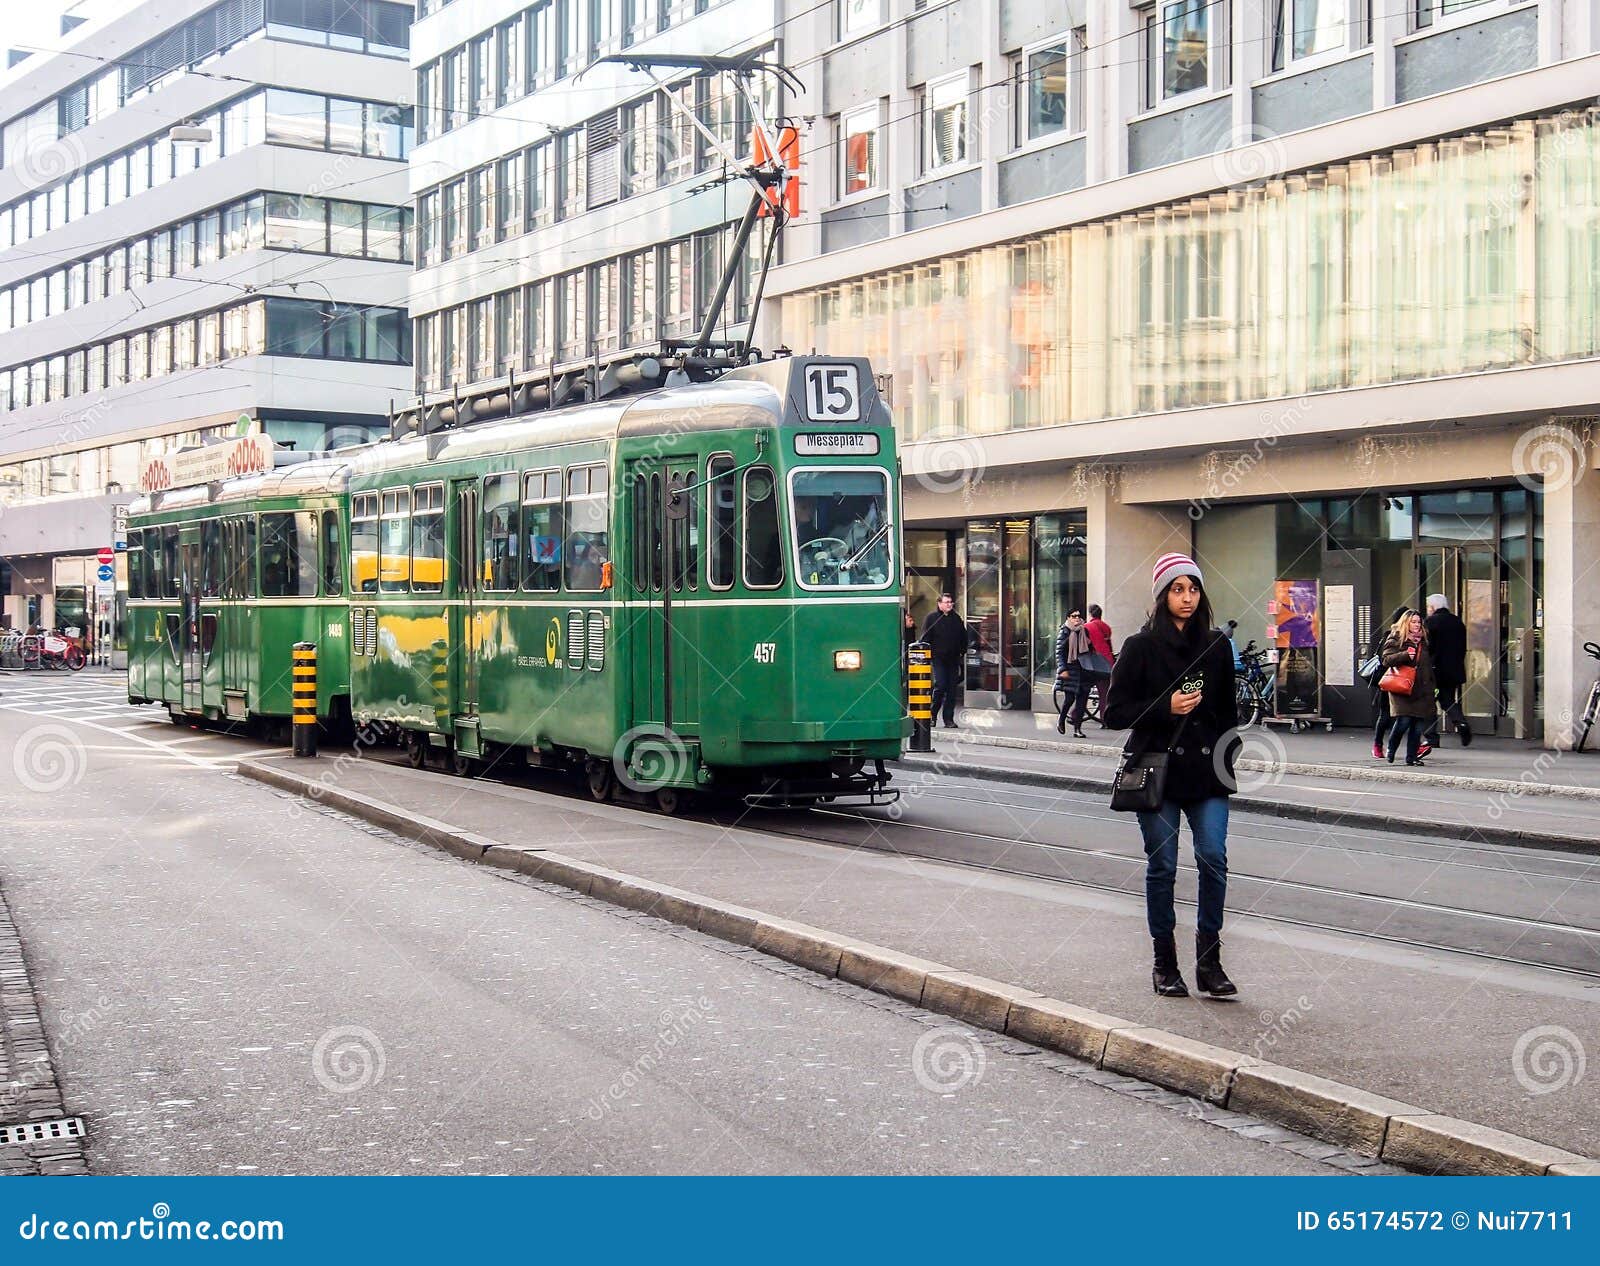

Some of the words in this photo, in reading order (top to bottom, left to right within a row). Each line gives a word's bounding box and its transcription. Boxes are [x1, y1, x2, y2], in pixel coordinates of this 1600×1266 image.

[809, 370, 853, 414] 15
[806, 433, 864, 449] Messeplatz
[754, 642, 776, 664] 457
